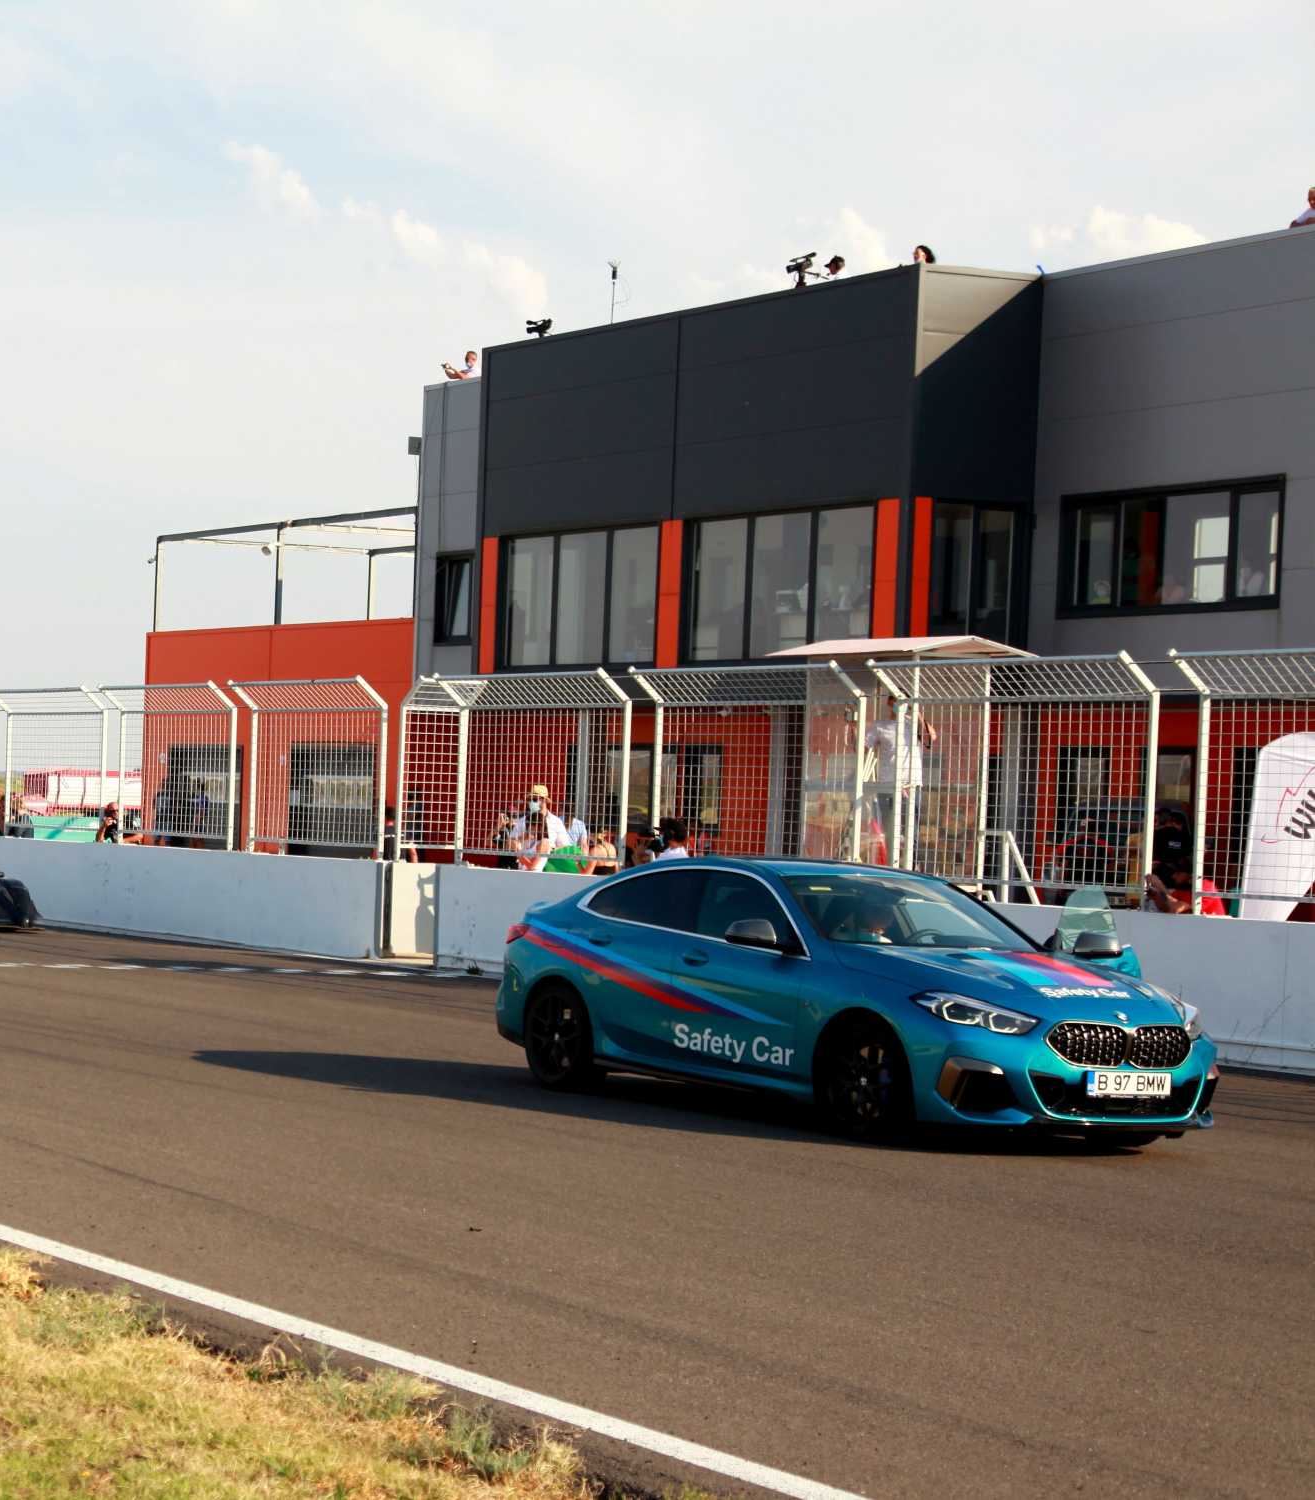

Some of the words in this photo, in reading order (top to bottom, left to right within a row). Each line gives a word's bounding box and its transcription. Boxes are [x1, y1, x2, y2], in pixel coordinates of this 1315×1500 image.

[1039, 987, 1098, 999] Safety
[1098, 988, 1132, 998] Car
[673, 1023, 747, 1063] Safety
[751, 1036, 795, 1066] Car
[1098, 1075, 1108, 1091] B
[1114, 1075, 1131, 1091] 97
[1136, 1076, 1167, 1092] BMW
